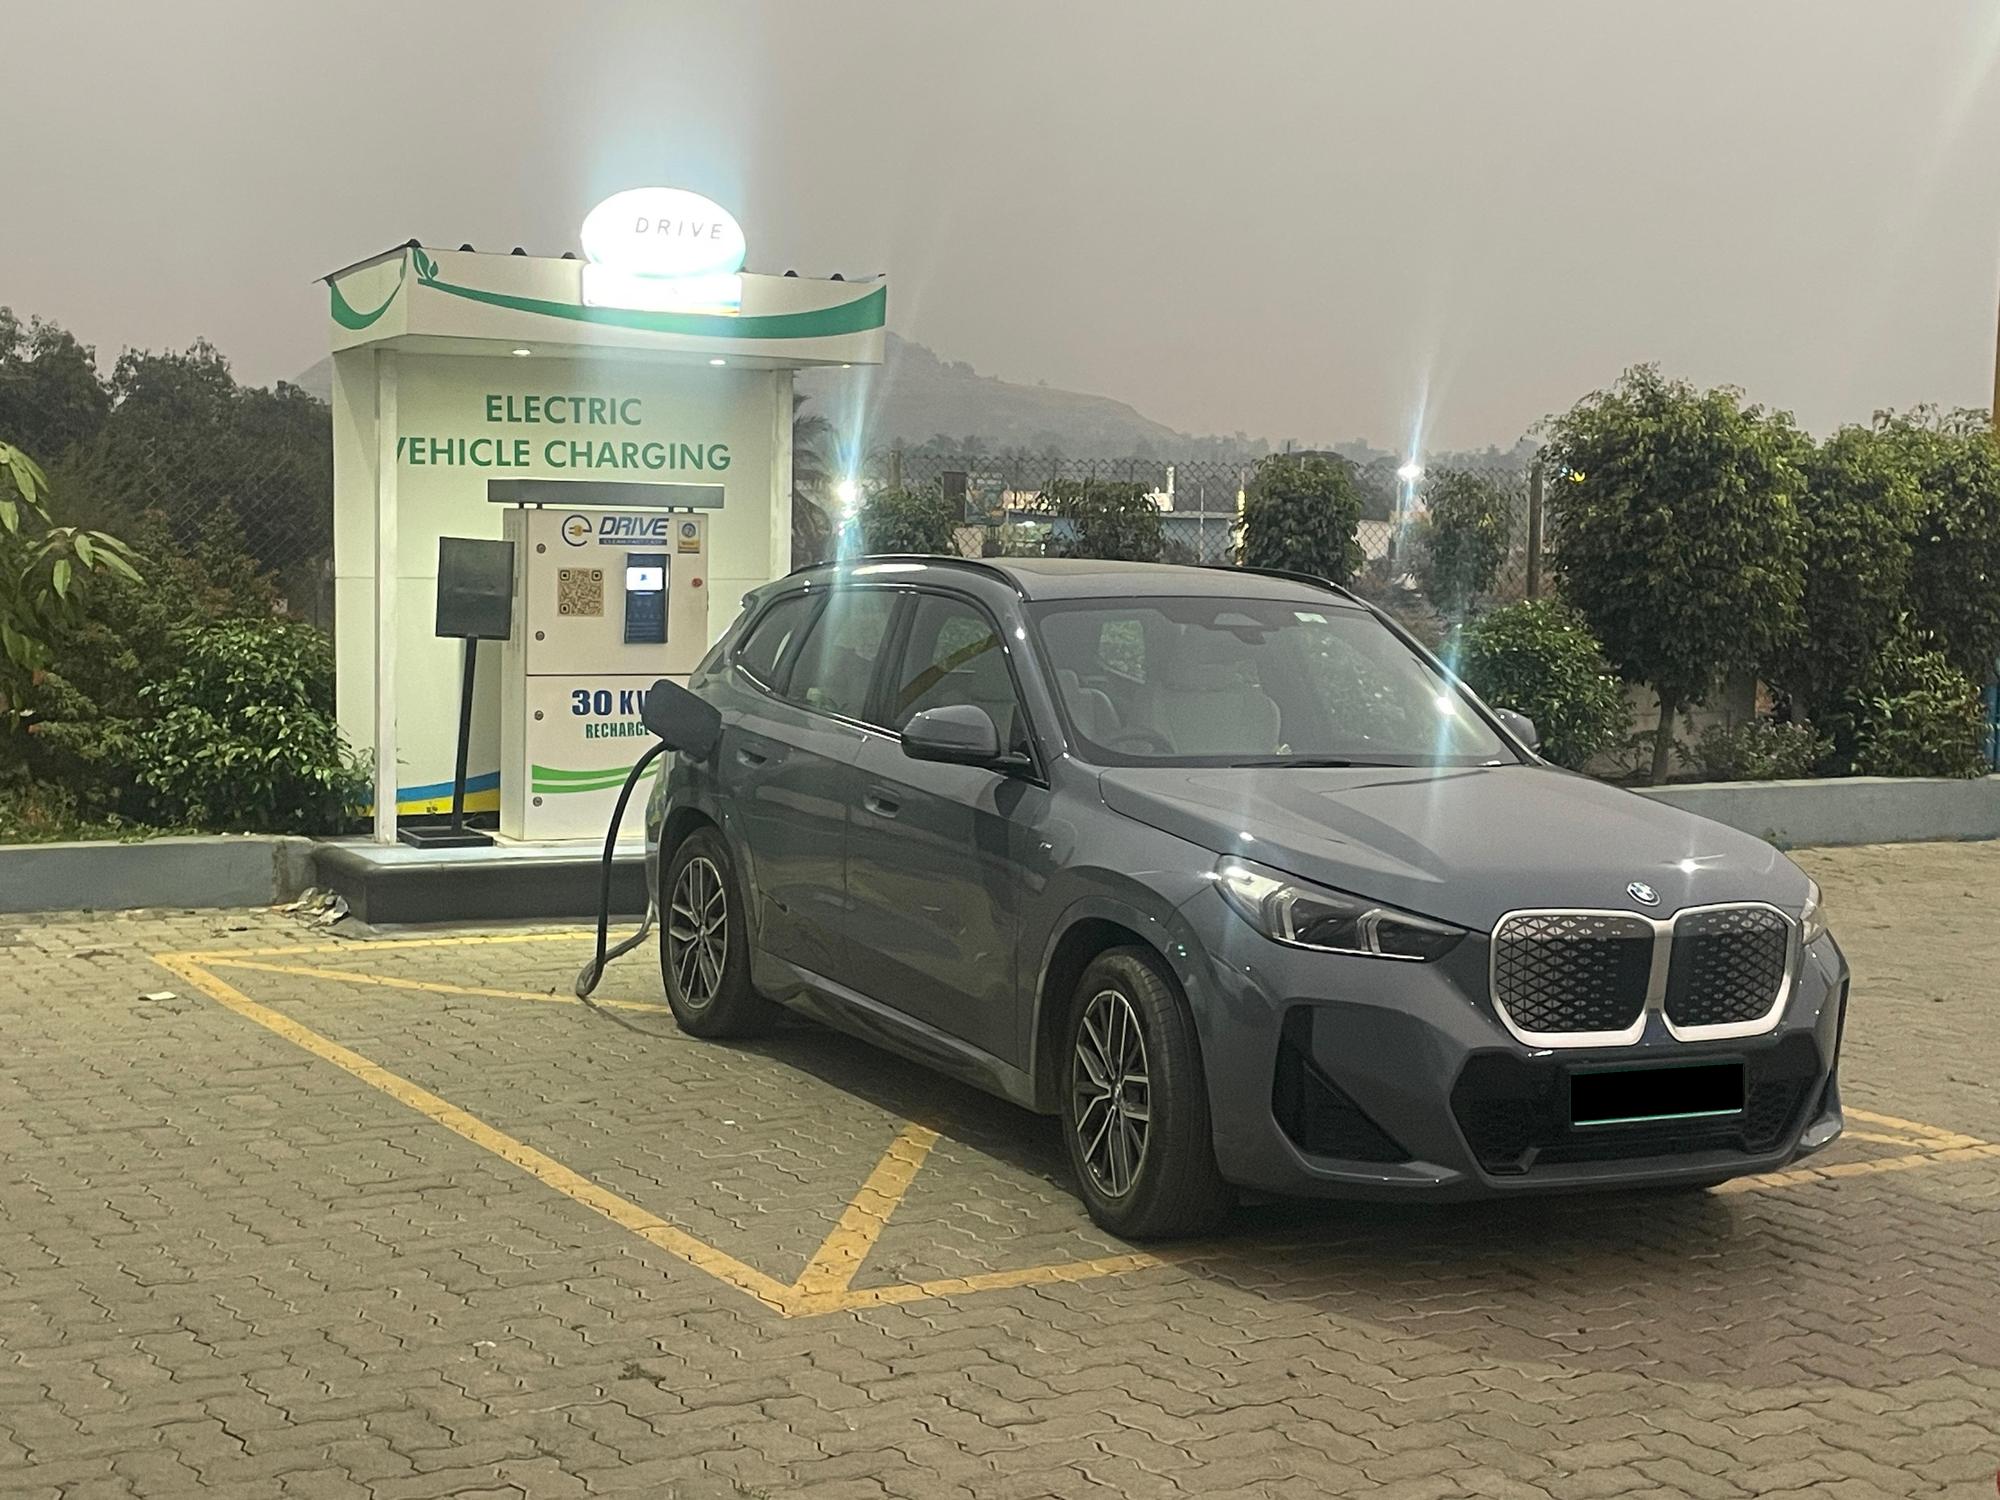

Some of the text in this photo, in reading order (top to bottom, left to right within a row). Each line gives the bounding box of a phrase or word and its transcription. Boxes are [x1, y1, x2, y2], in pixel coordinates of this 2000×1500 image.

[635, 216, 723, 239] DRIVE
[486, 394, 642, 426] ELECTRIC
[544, 440, 731, 471] CHARGING
[599, 516, 669, 536] DRIVE
[572, 690, 612, 716] 30
